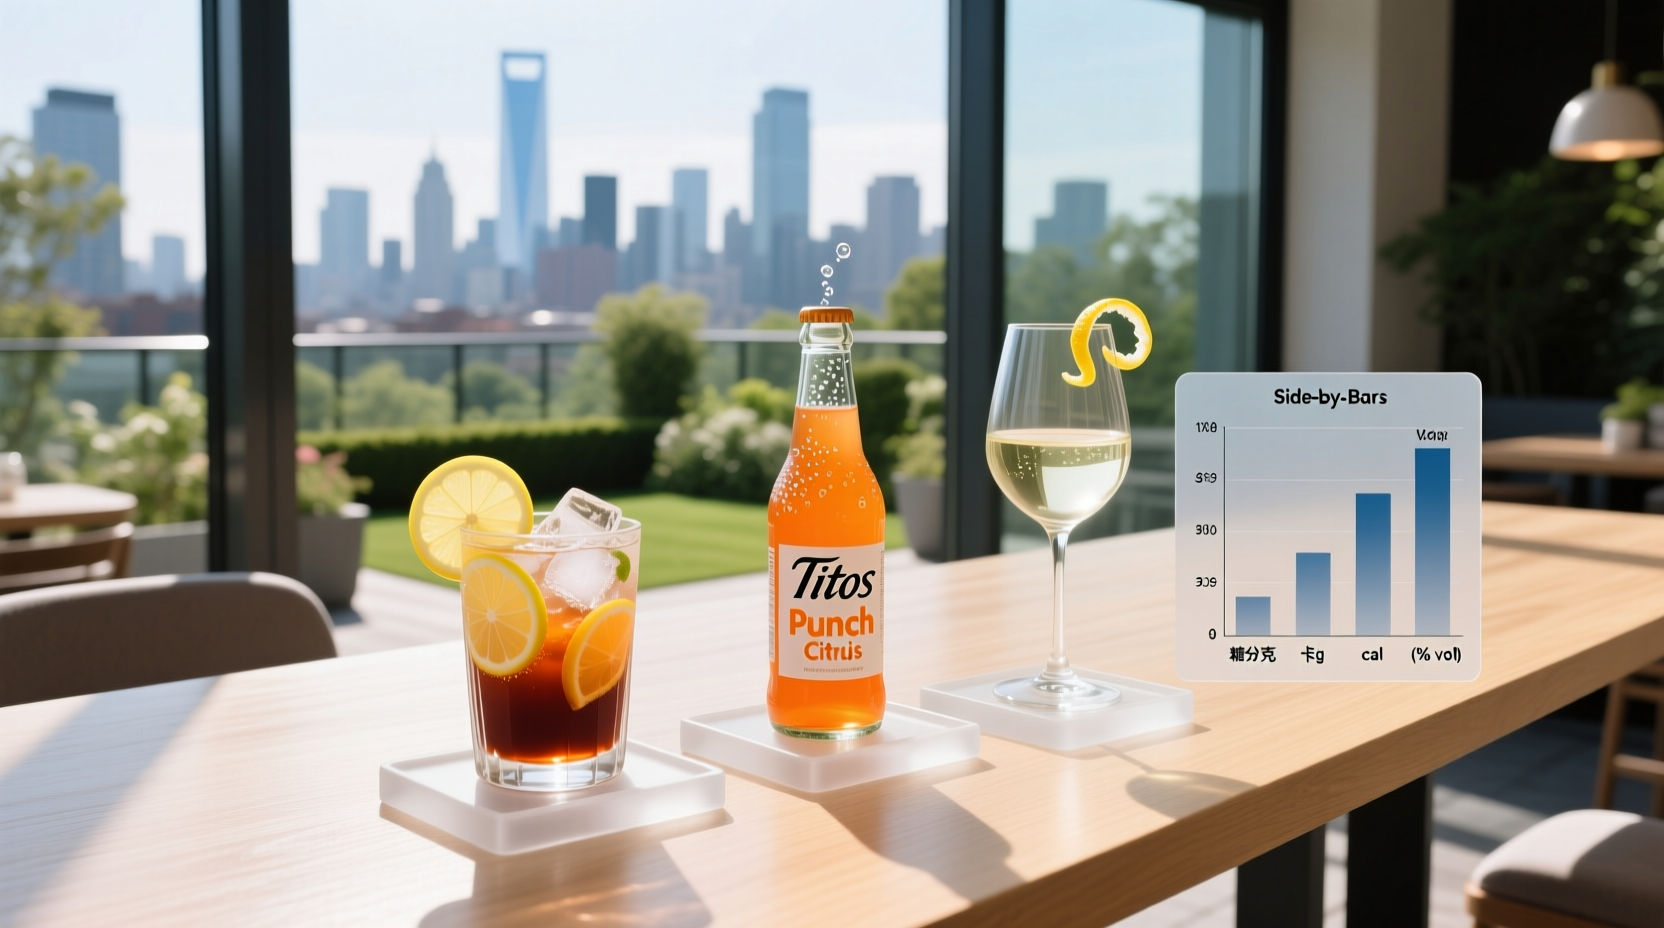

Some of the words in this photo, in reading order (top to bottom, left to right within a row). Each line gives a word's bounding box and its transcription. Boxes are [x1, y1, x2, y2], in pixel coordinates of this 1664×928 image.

[791, 556, 876, 600] Titos
[789, 605, 874, 637] Punch
[803, 641, 863, 661] Citrus
